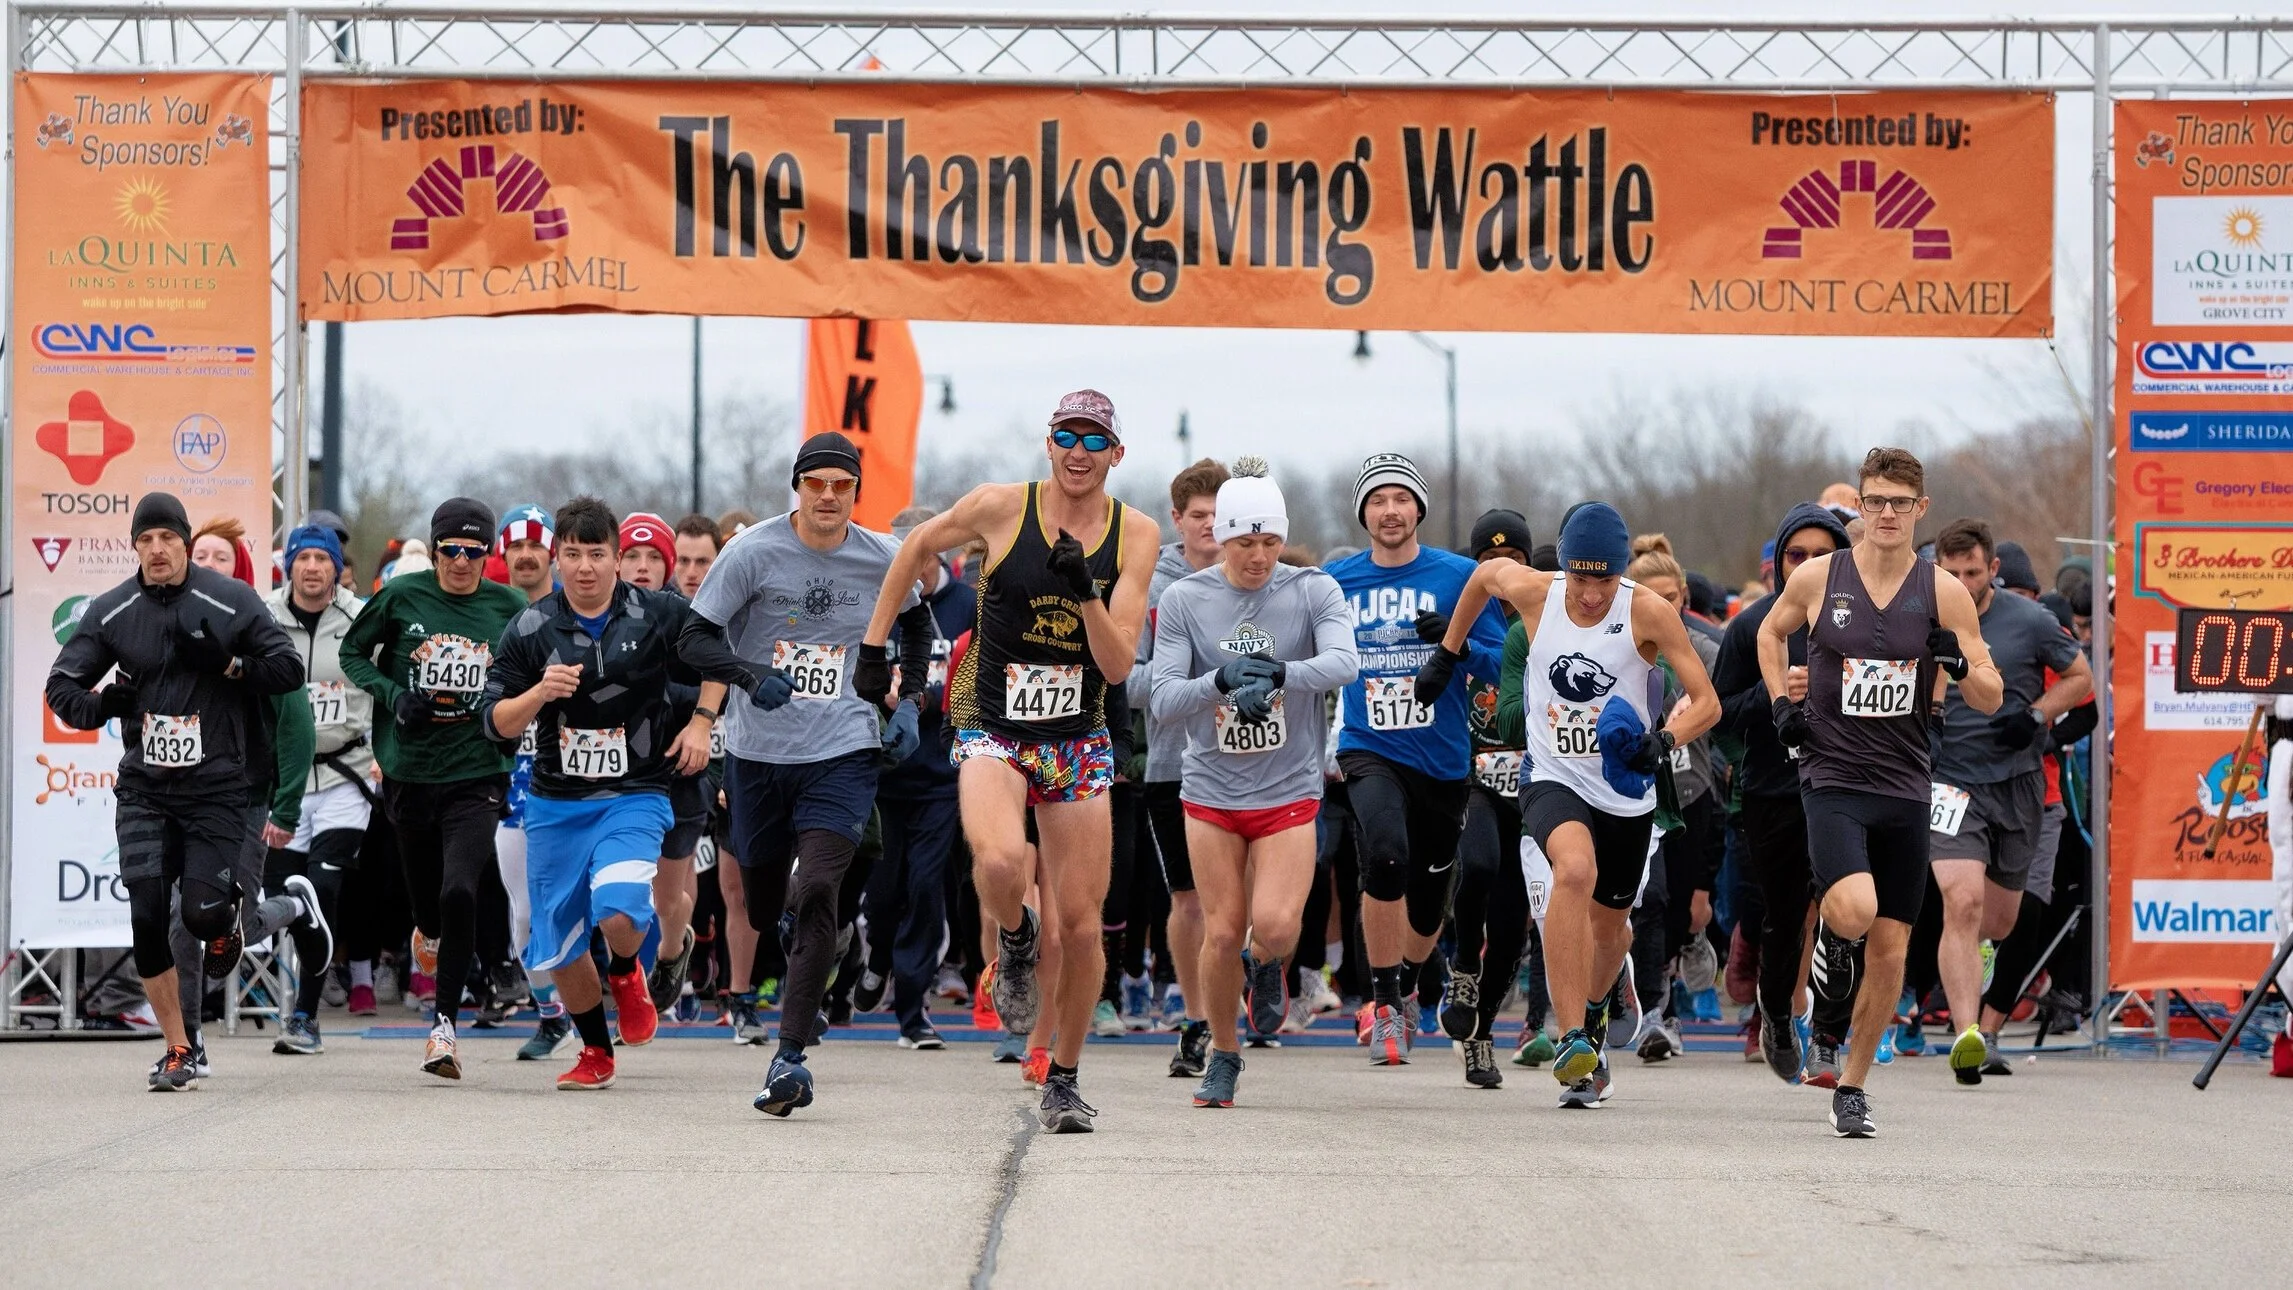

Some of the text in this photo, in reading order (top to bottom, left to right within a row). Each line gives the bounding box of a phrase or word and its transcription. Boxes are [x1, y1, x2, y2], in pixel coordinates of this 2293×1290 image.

[74, 96, 210, 125] Thank You
[380, 99, 586, 141] Presented by:
[1751, 112, 1972, 150] Presented by:
[2176, 114, 2255, 145] Thank
[80, 135, 211, 171] Sponsors!
[660, 115, 1655, 306] The Thanksgiving Wattle
[78, 235, 238, 274] QUINTA
[70, 277, 217, 290] INNS & SUITES
[323, 257, 640, 304] MOUNT CARMEL
[2190, 281, 2223, 289] INNS
[82, 297, 109, 309] wake
[110, 299, 122, 311] up
[139, 297, 155, 309] the
[157, 297, 185, 311] bright
[1688, 279, 2024, 316] MOUNT CARMEL
[2203, 307, 2286, 319] GROVE CITY
[42, 324, 167, 352] CWC
[2144, 342, 2266, 370] CWC
[32, 365, 101, 376] COMMERCIAL
[105, 365, 170, 376] WAREHOUSE
[2134, 383, 2200, 393] COMMERCIAL
[2205, 383, 2269, 393] WAREHOUSE
[2195, 481, 2256, 497] Gregory
[42, 493, 130, 514] TOSOH
[1568, 560, 1608, 571] VIKINGS
[2154, 544, 2172, 568] 3
[2176, 547, 2266, 568] Brothers
[806, 577, 834, 587] OHIO
[1030, 594, 1060, 609] DARBY
[1830, 592, 1854, 600] GOLDEN
[1022, 632, 1083, 652] CROSS COUNTRY
[1228, 638, 1267, 652] NAVY
[426, 661, 480, 688] 5430
[1013, 687, 1076, 717] 4472
[1847, 683, 1909, 713] 4402
[1372, 699, 1429, 727] 5173
[1224, 721, 1282, 751] 4803
[146, 736, 196, 764] 4332
[568, 748, 623, 774] 4779
[2133, 902, 2278, 932] Walmar
